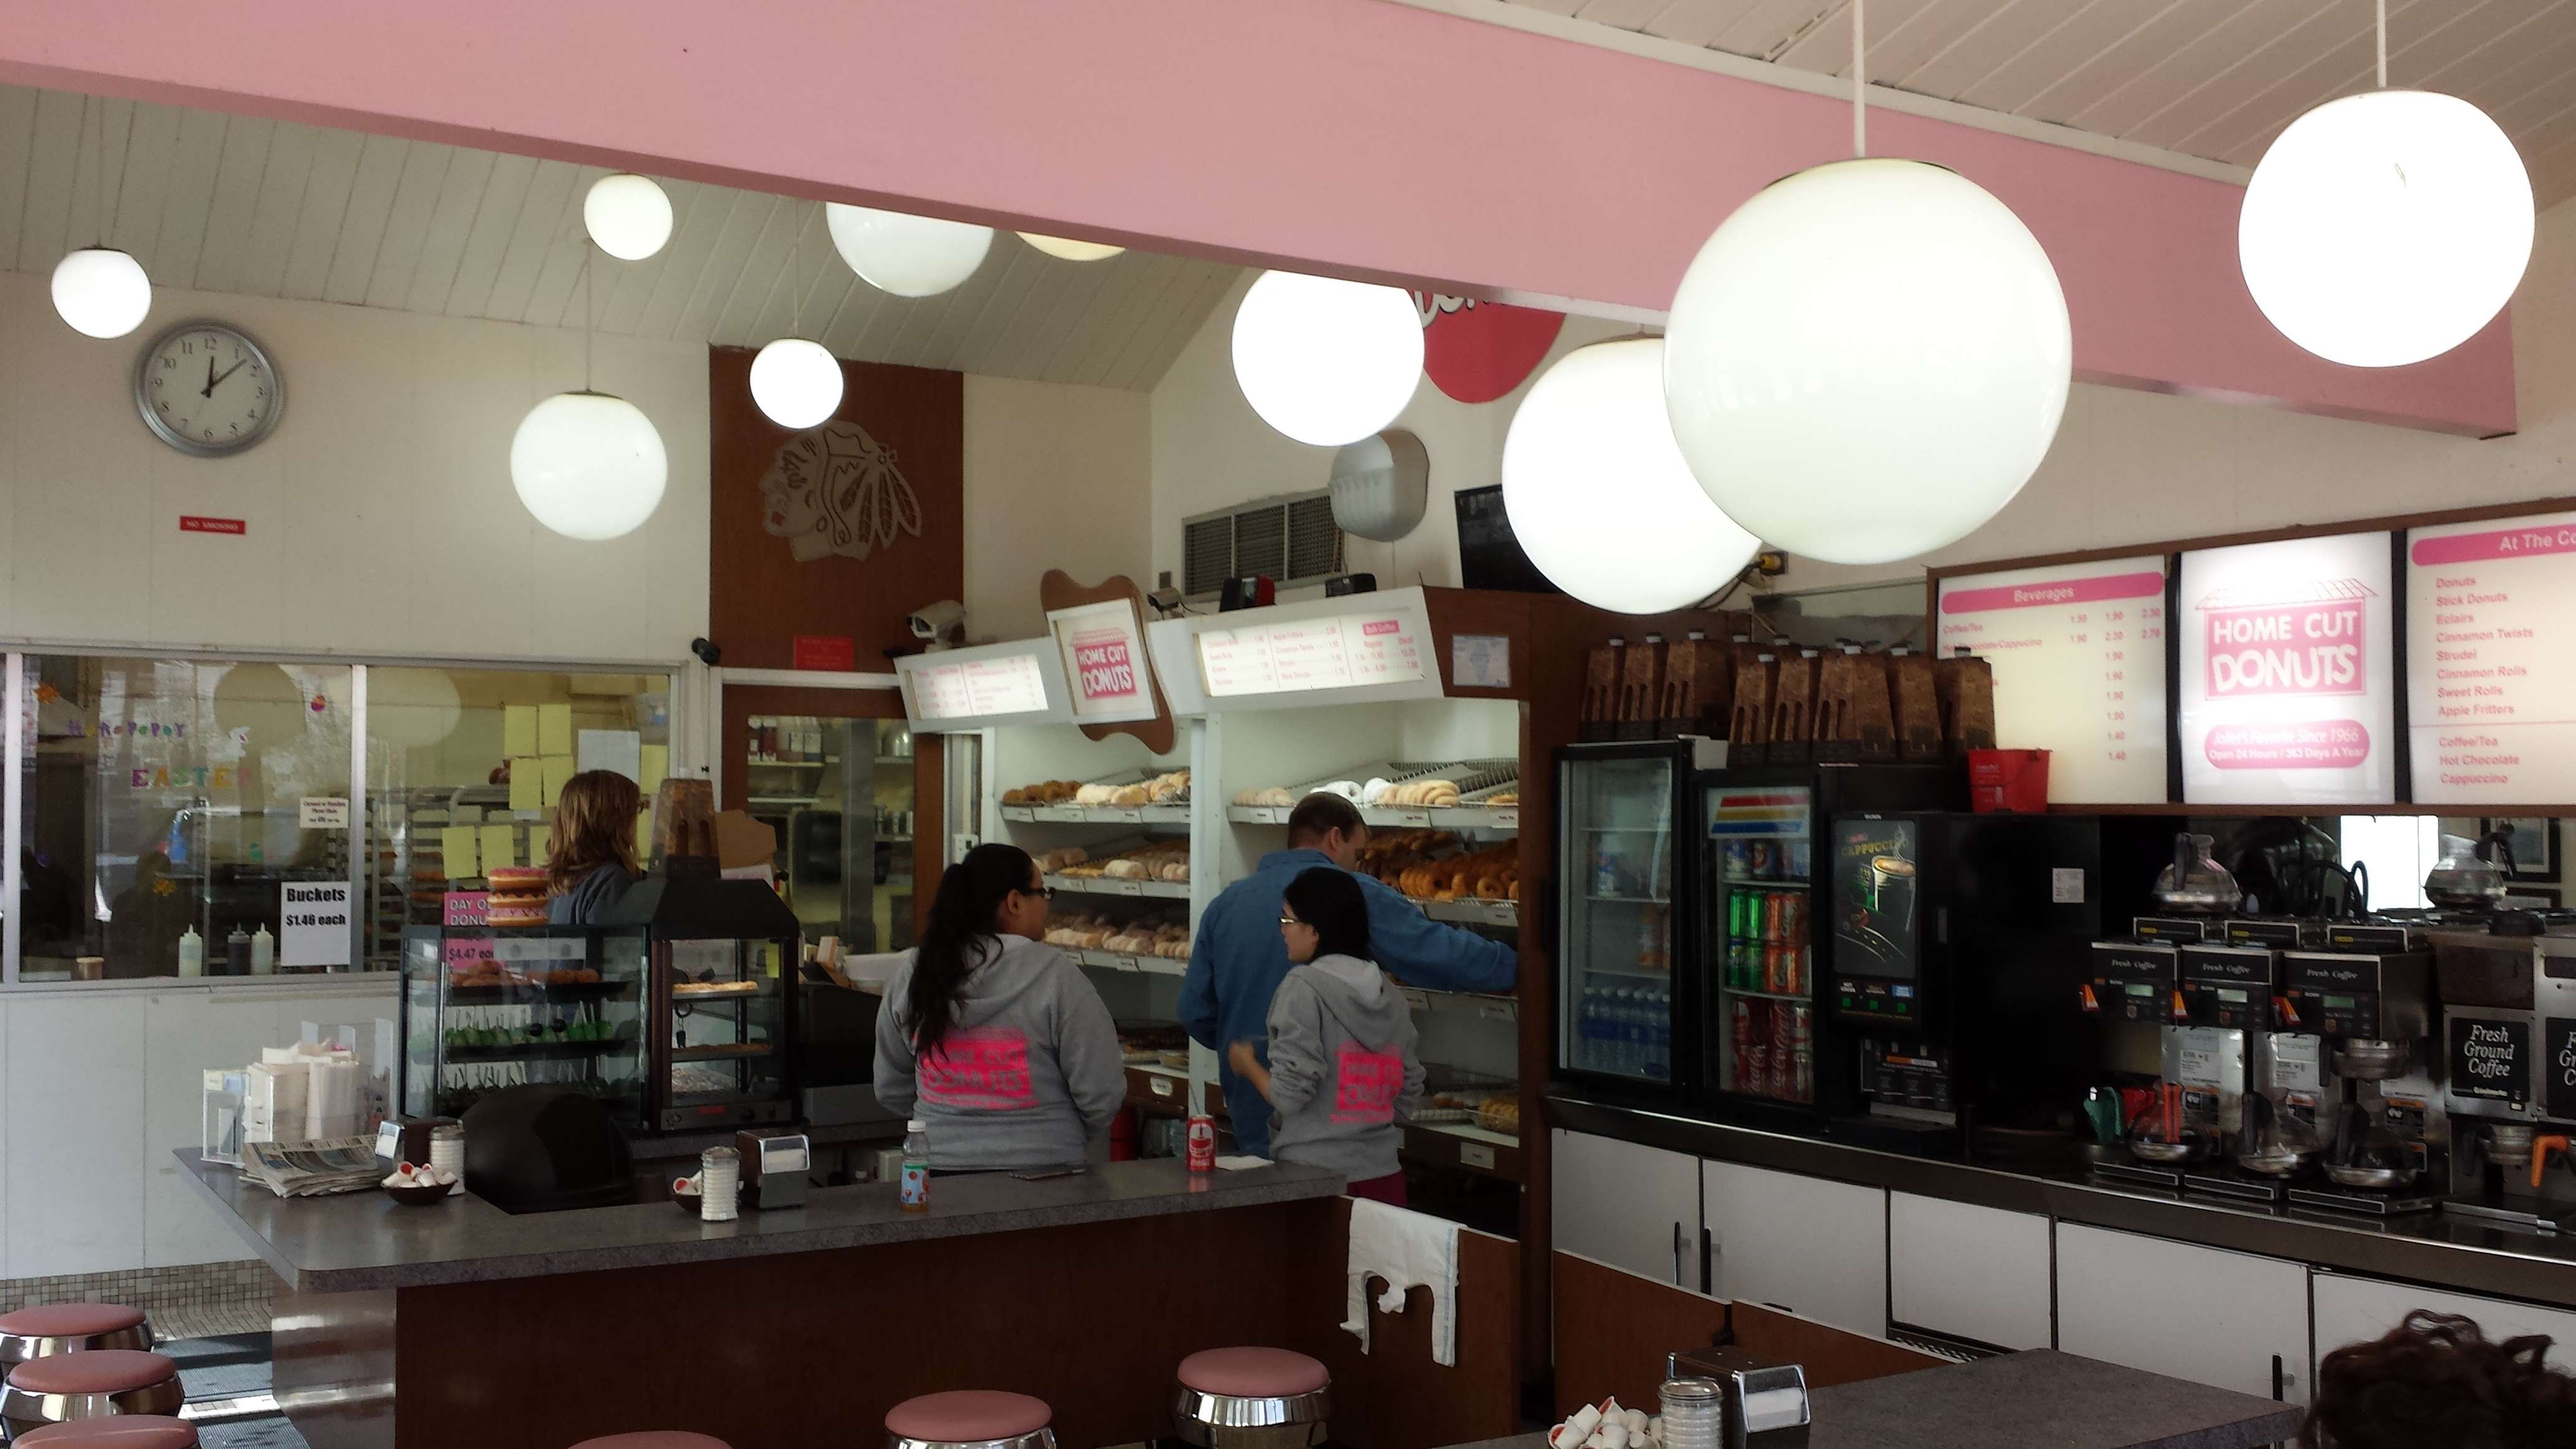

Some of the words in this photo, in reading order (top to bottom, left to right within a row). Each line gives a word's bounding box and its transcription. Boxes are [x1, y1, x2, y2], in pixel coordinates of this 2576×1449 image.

[2499, 535, 2518, 552] At
[2523, 533, 2552, 549] The
[2436, 577, 2476, 588] Donuts
[2014, 585, 2075, 603] Beverages
[2436, 594, 2464, 607] Stick
[2467, 592, 2508, 604] Donuts
[2436, 613, 2474, 625] Eclairs
[2213, 614, 2292, 645] HOME
[2304, 609, 2358, 639] CUT
[2436, 630, 2494, 643] Cinnamon
[2497, 628, 2534, 640] Twists
[1078, 648, 1106, 666] HOME
[1107, 644, 1126, 663] CUT
[2436, 649, 2477, 661] Strudel
[2211, 643, 2358, 693] DONUTS
[2437, 667, 2495, 680] Cinnamon
[2497, 665, 2527, 677] Rolls
[1083, 664, 1133, 696] DONUTS
[2437, 687, 2471, 698] Sweet
[2474, 685, 2504, 697] Rolls
[2438, 705, 2470, 717] Apple
[2473, 703, 2515, 716] Fritters
[2296, 728, 2328, 743] Since
[2439, 735, 2498, 748] Coffee/Tea
[2208, 749, 2234, 761] Open
[2249, 748, 2278, 759] Hours
[2305, 748, 2330, 761] Days
[2331, 747, 2341, 758] A
[2440, 754, 2459, 766] Hot
[2462, 754, 2520, 766] Chocolate
[286, 888, 346, 902] Buckets
[450, 898, 473, 912] DAY
[318, 914, 346, 925] each
[451, 914, 488, 926] DONU
[2469, 1024, 2509, 1043] Fresh
[2464, 1041, 2515, 1060] Ground
[2468, 1057, 2511, 1079] Coffee
